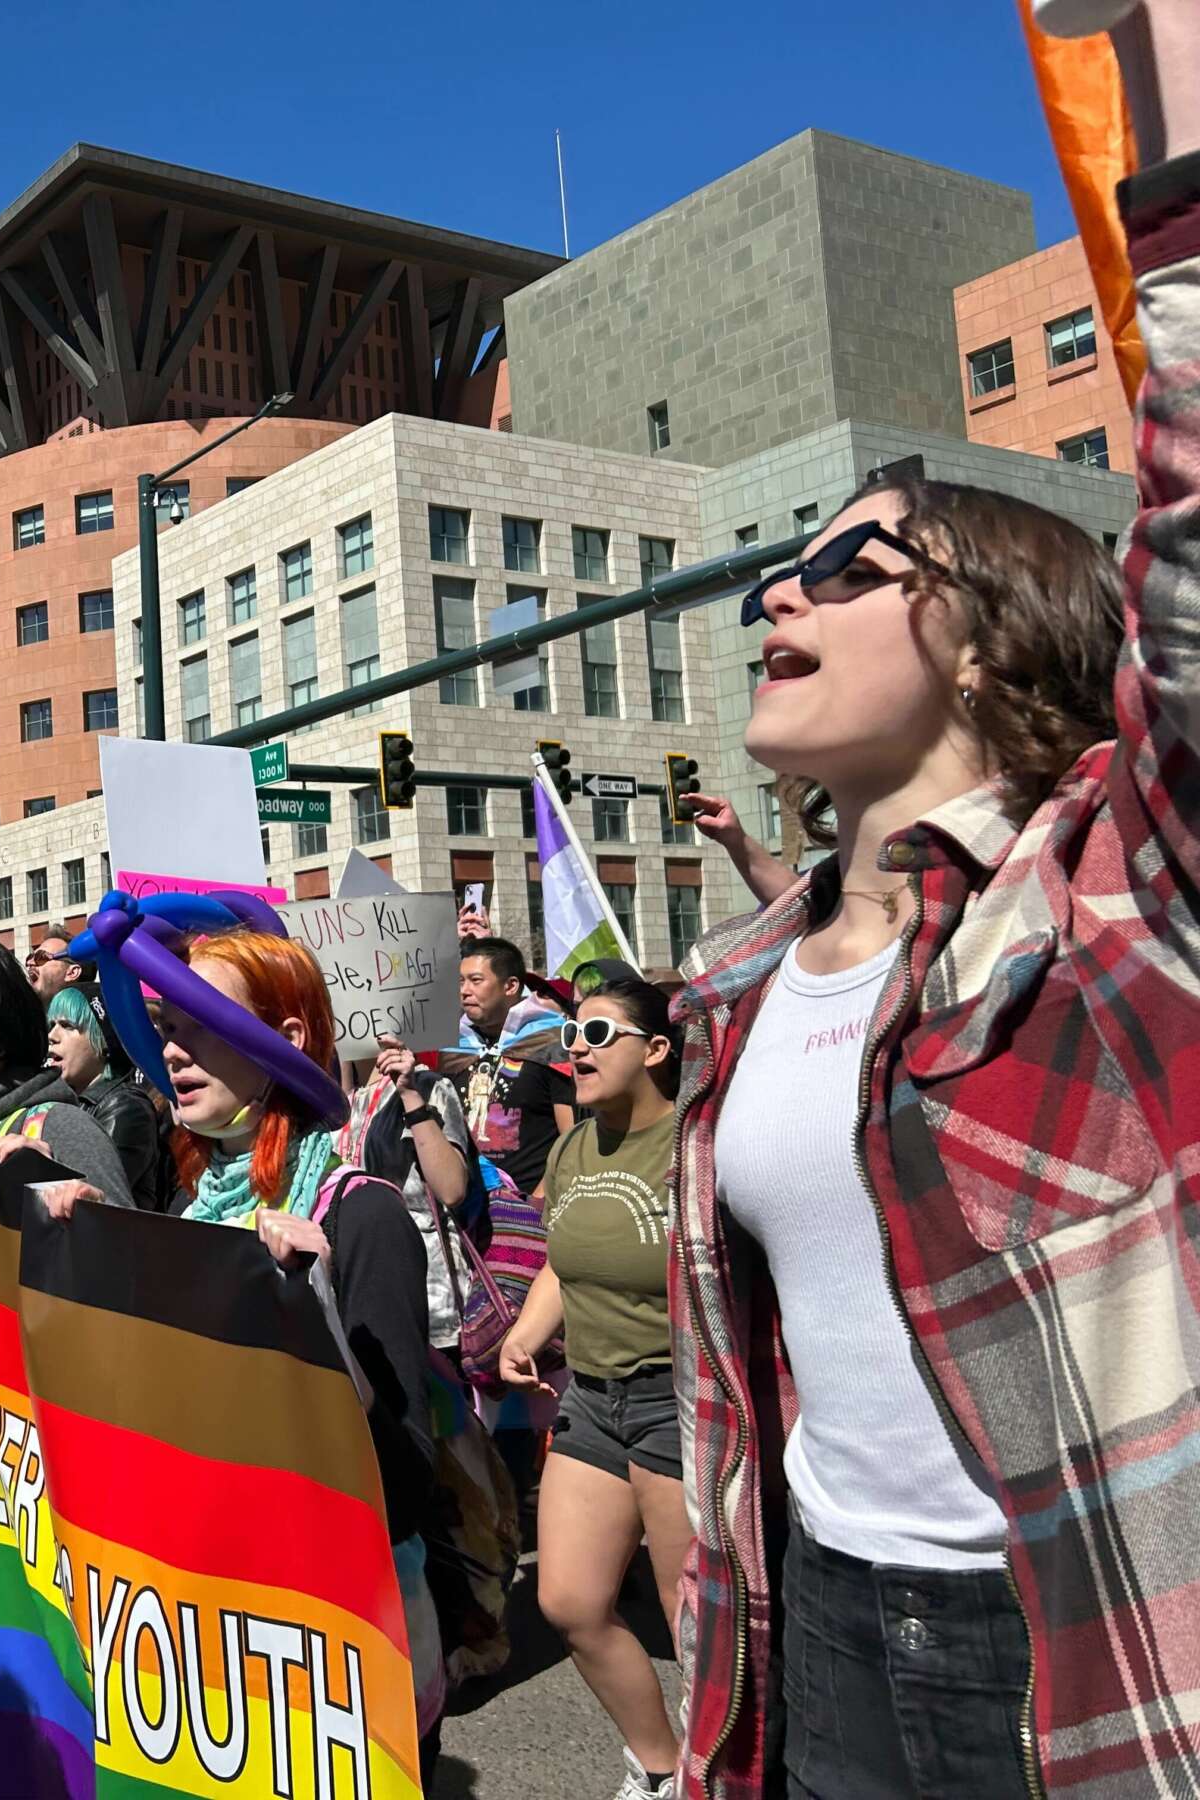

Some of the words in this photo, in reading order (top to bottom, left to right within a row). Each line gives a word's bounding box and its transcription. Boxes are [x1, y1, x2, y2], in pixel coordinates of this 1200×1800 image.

[265, 752, 277, 762] Ave
[258, 767, 276, 780] 1300
[277, 764, 283, 775] N
[599, 782, 612, 790] ONE
[372, 901, 419, 942] KILL
[374, 947, 438, 987] DRAG!
[602, 1170, 619, 1179] AND
[84, 1563, 373, 1800] YOUTH
